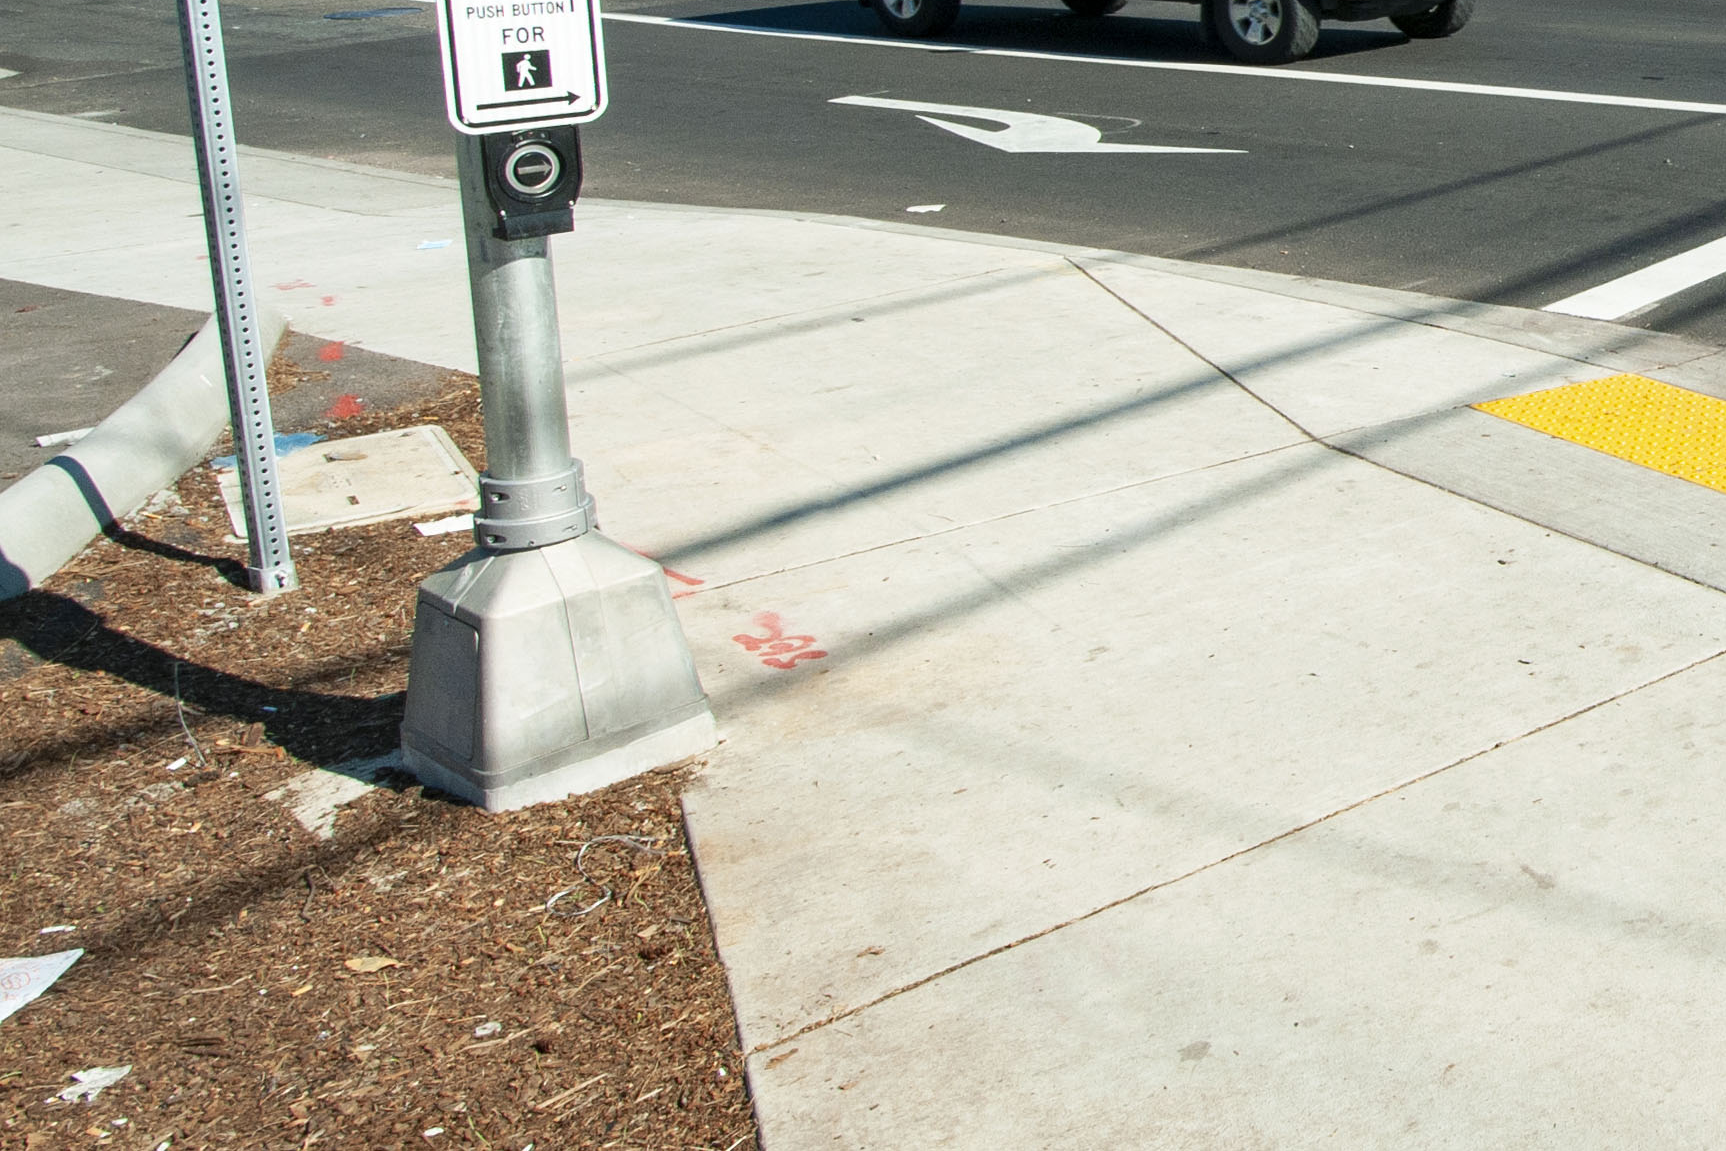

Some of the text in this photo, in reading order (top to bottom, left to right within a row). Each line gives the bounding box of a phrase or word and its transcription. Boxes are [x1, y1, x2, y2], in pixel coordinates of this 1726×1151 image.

[466, 1, 564, 19] PUSH BUTTON
[502, 26, 545, 44] FOR
